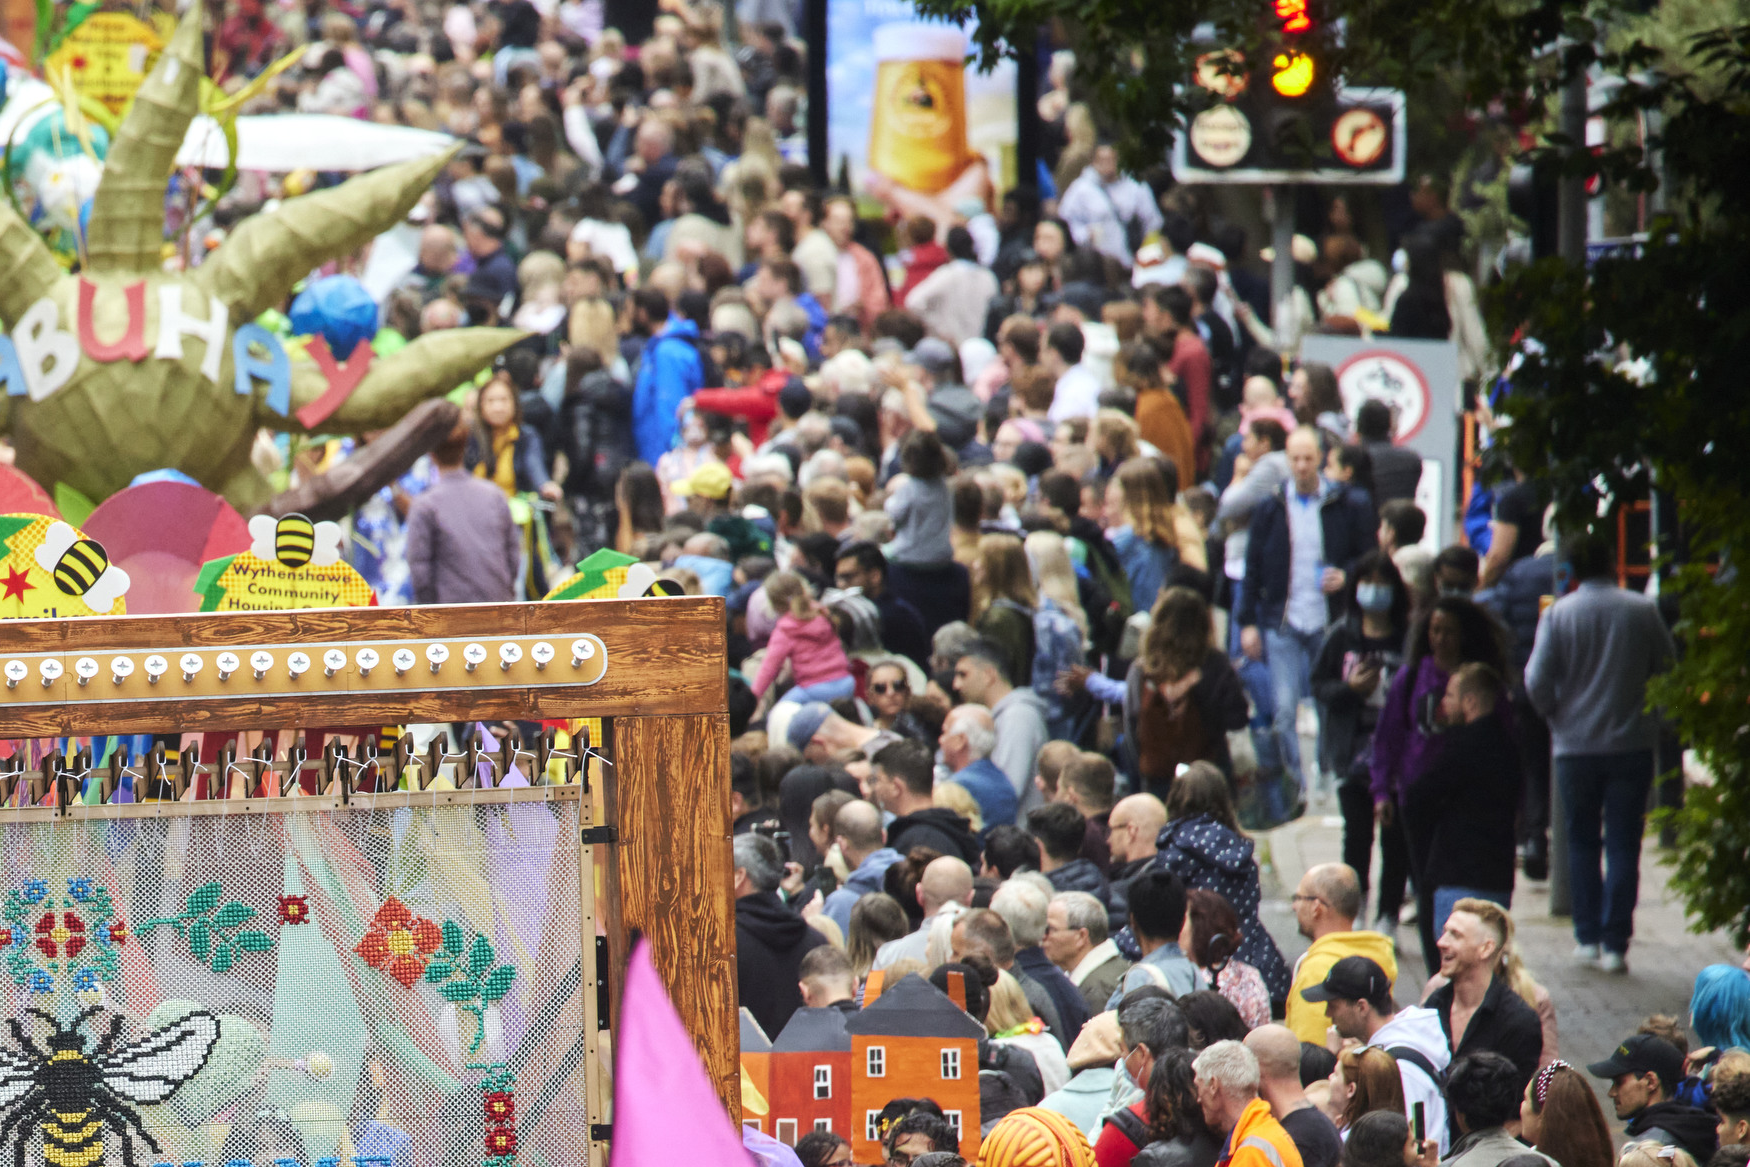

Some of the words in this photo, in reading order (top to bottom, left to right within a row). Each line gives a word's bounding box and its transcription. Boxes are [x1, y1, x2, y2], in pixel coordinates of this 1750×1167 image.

[233, 563, 351, 584] Wythenshawe
[247, 582, 340, 604] Community
[229, 598, 293, 611] Housin
